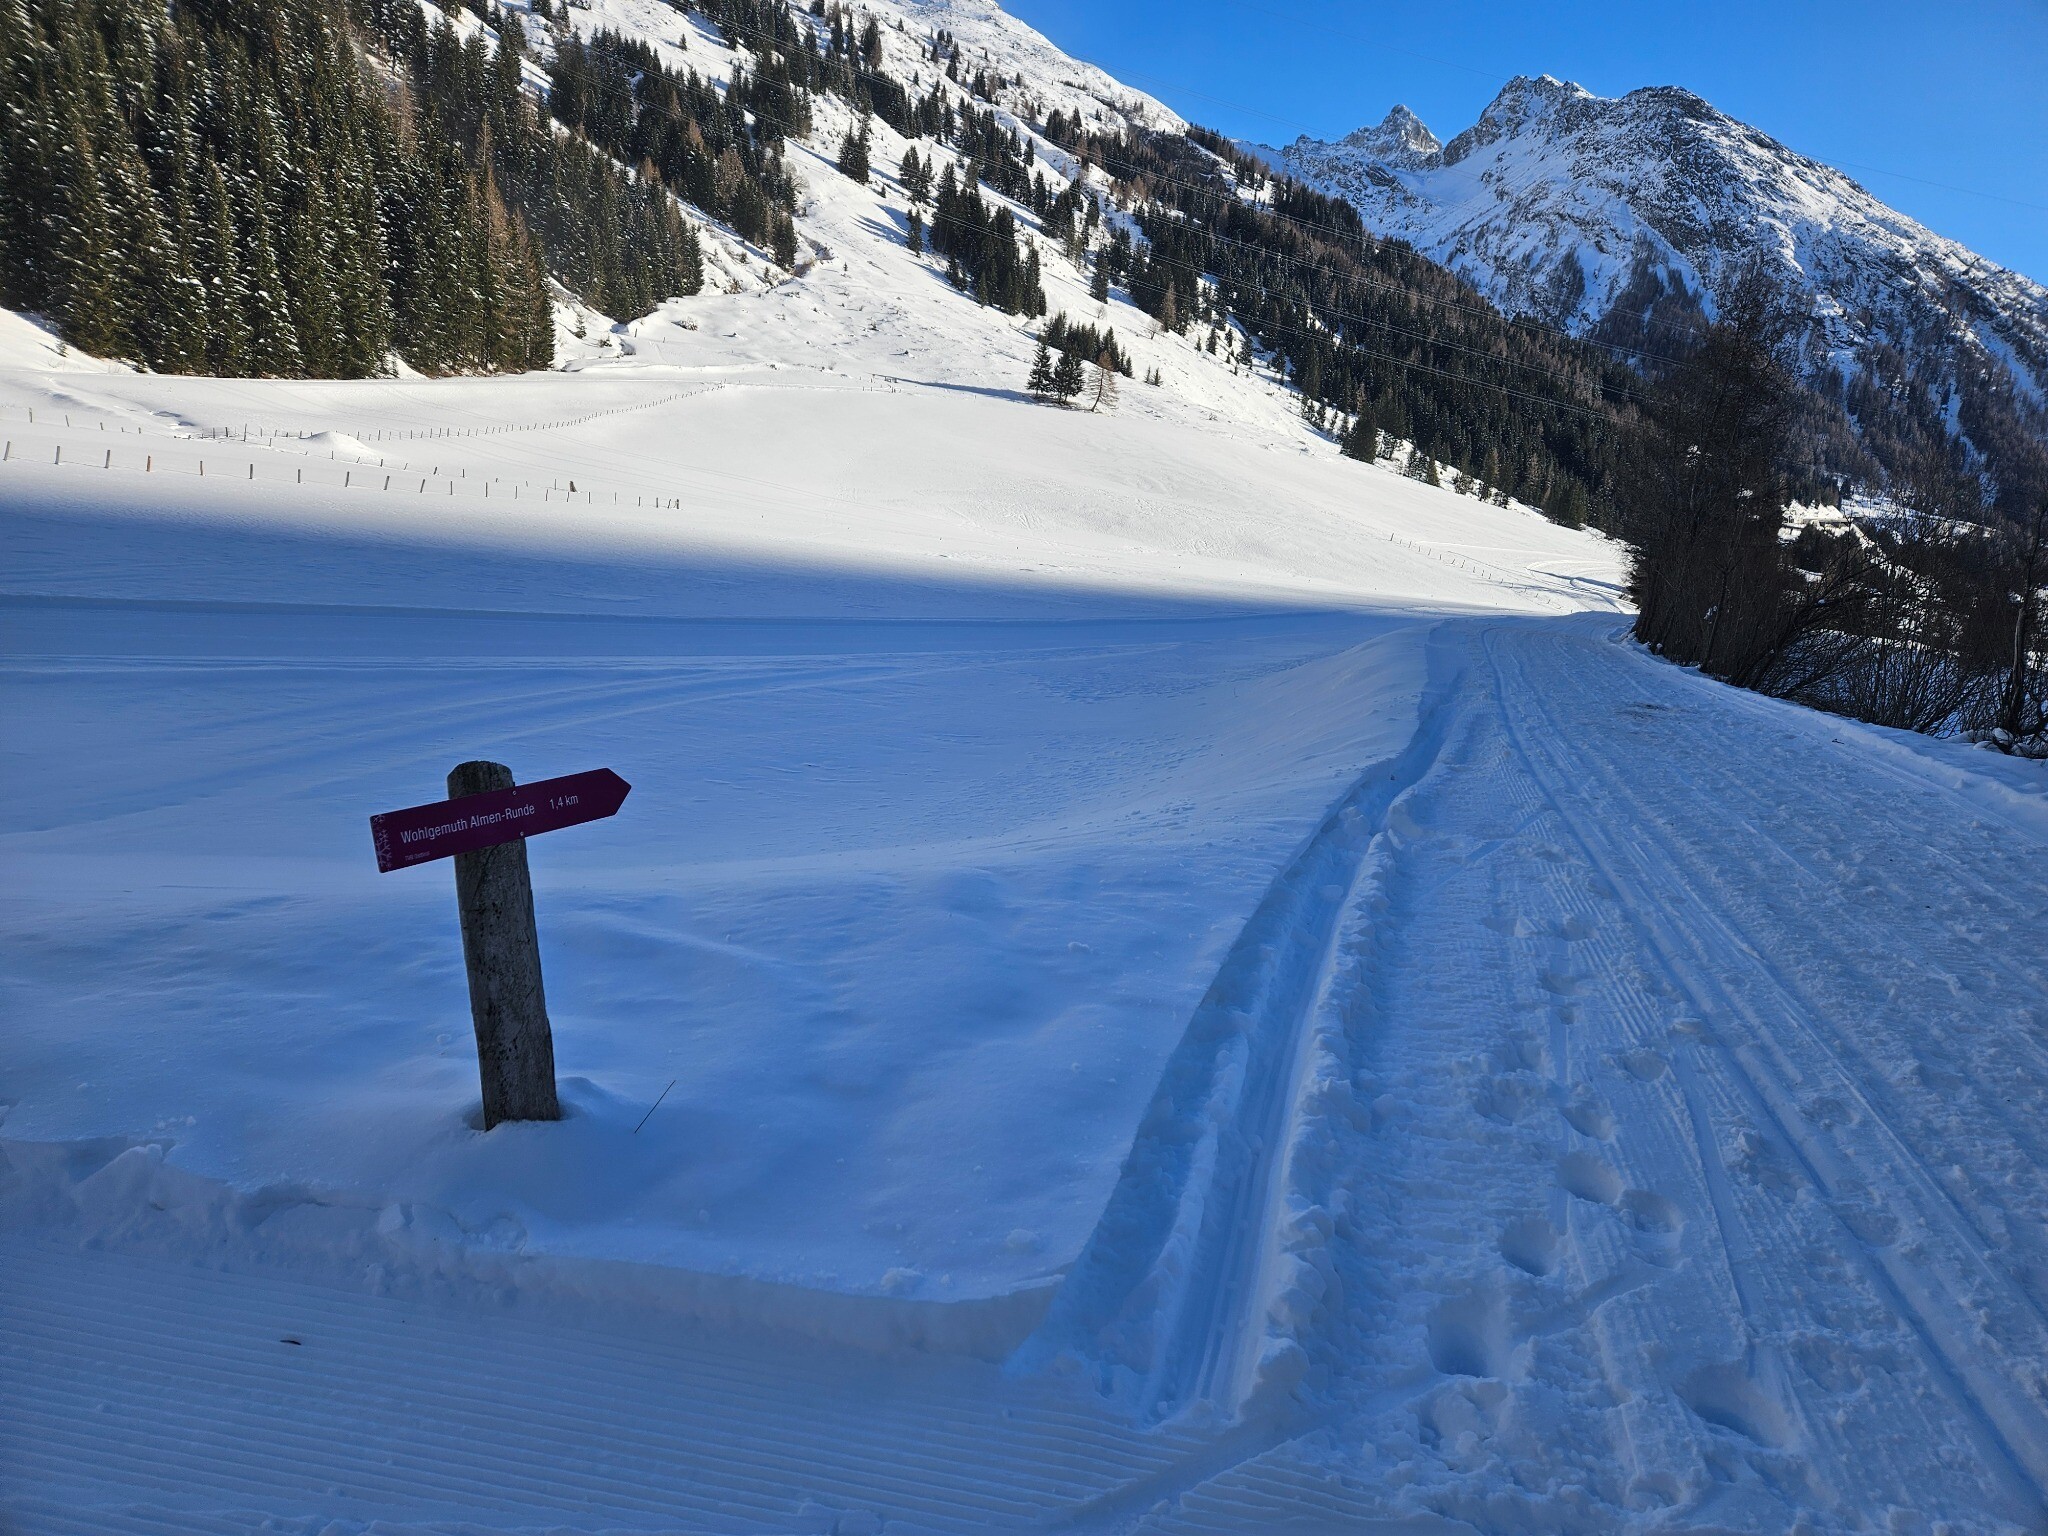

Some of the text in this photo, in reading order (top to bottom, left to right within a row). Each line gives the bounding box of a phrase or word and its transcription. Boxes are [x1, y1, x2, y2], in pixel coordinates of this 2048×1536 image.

[400, 794, 579, 844] Wohlgemuth Almen-Runde 1,4 km
